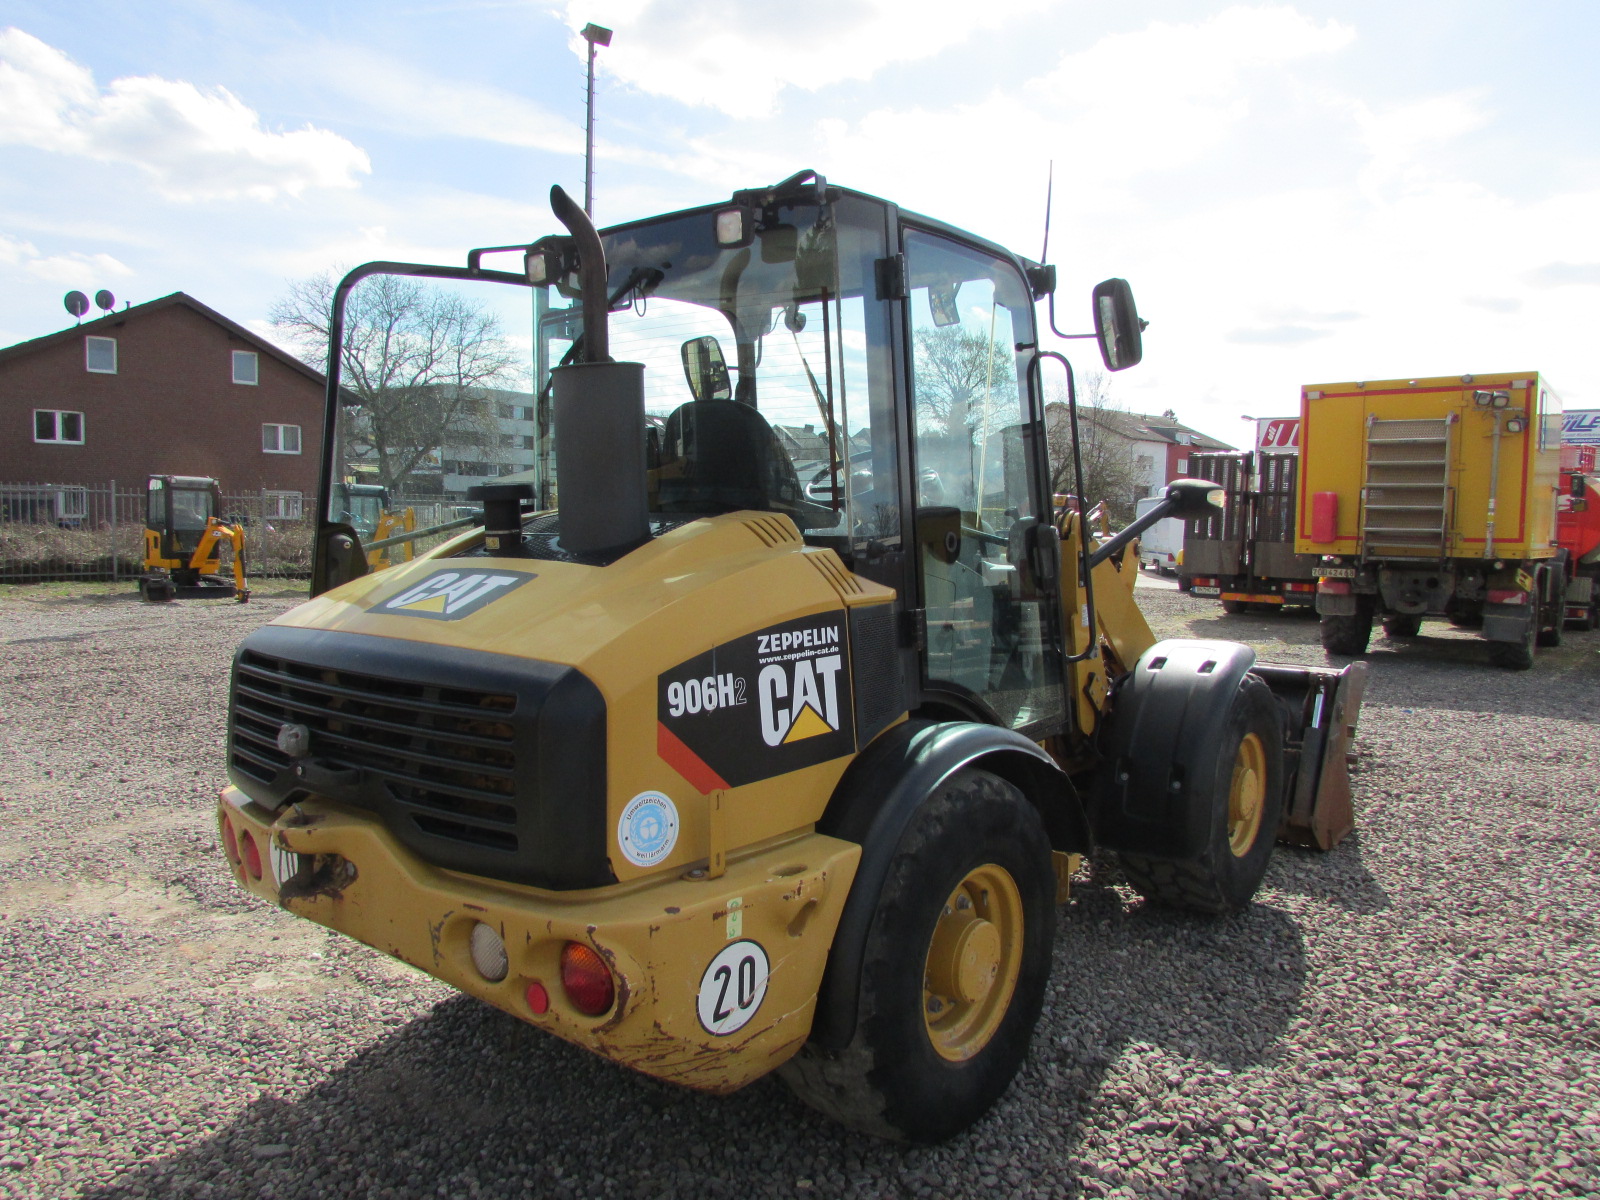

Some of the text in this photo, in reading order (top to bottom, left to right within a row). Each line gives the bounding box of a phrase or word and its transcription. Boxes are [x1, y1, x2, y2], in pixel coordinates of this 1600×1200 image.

[386, 572, 519, 614] CAT
[757, 625, 839, 654] ZEPPELIN
[758, 645, 839, 664] www.zeppelin-cat.de
[758, 654, 842, 747] CAT
[626, 797, 667, 821] Umweltzeichen
[636, 851, 648, 859] weil
[712, 955, 756, 1024] 20
